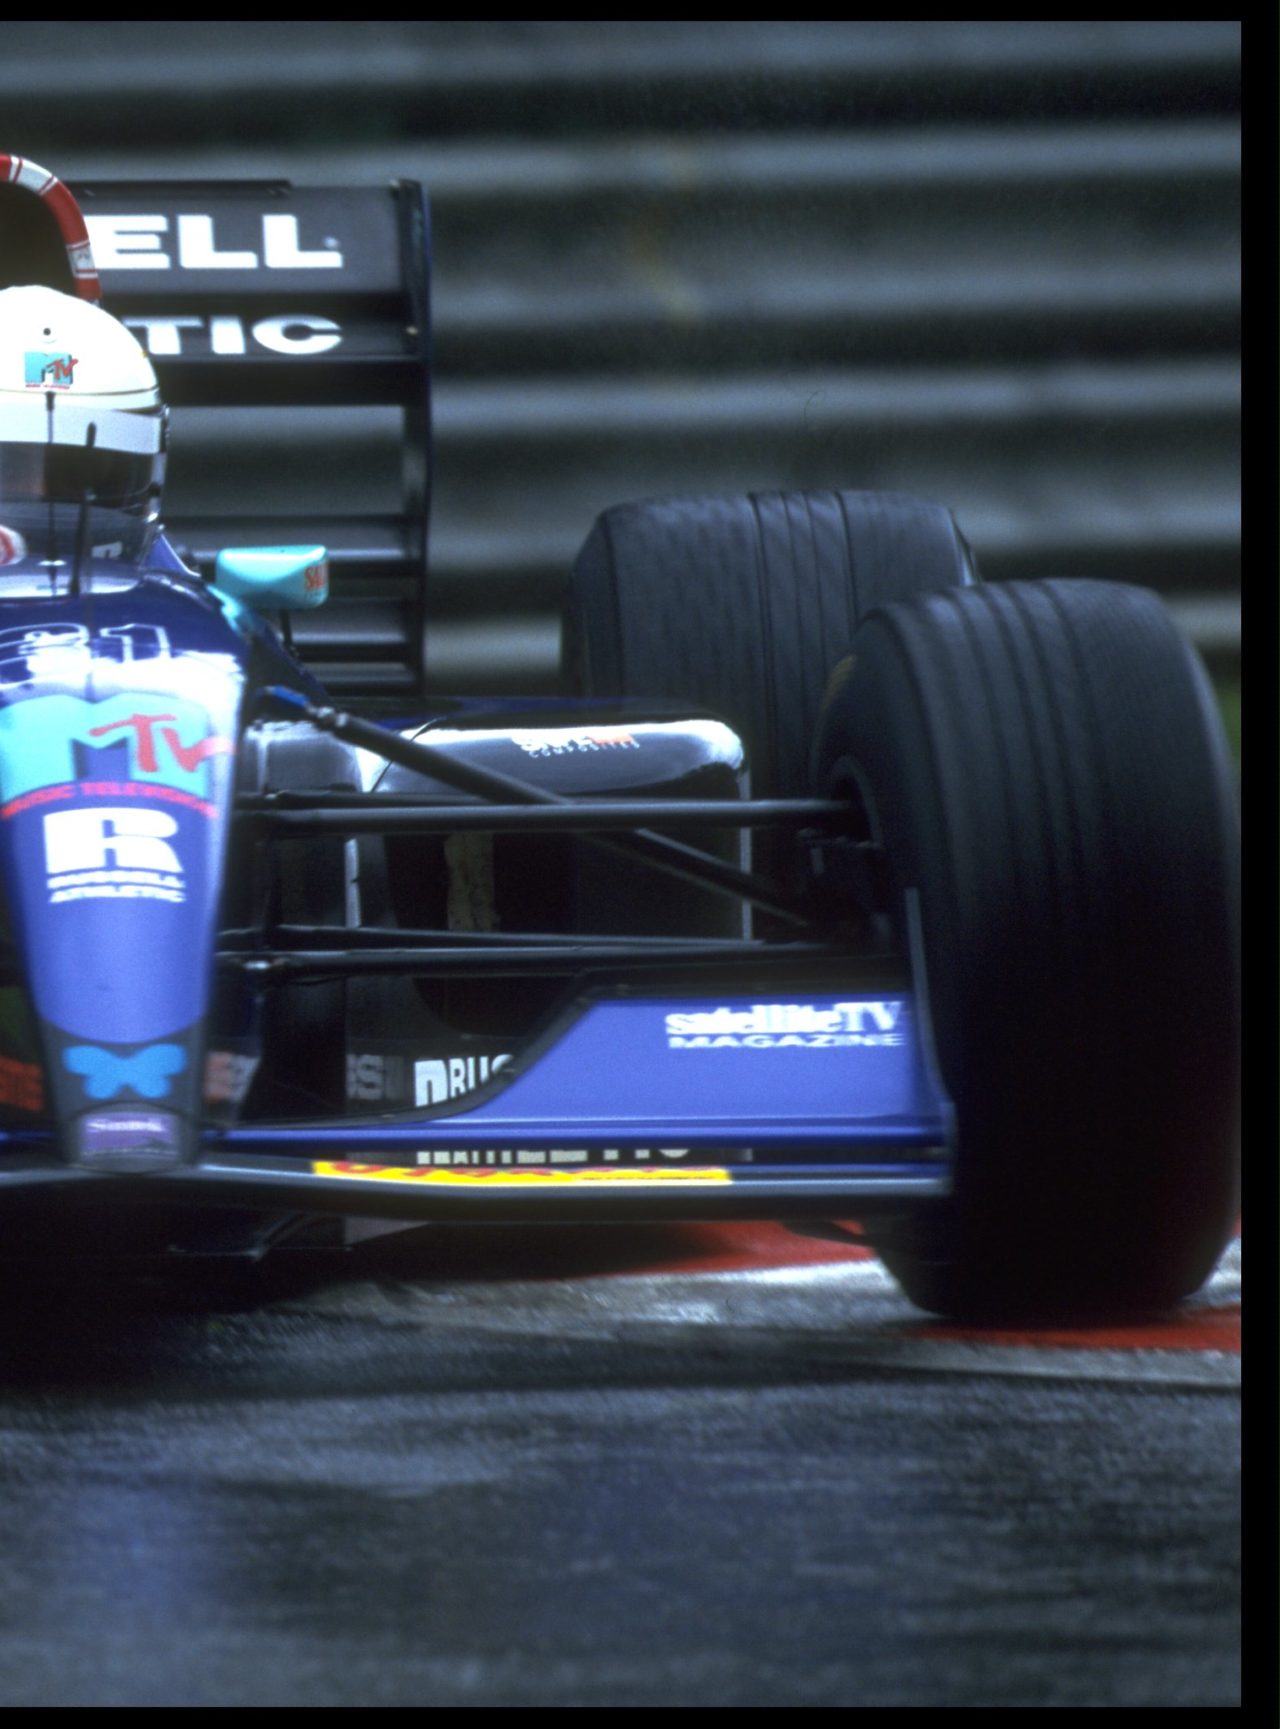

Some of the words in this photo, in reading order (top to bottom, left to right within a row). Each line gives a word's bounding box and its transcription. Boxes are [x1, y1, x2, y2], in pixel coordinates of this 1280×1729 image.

[24, 351, 79, 384] MTV
[42, 806, 185, 875] R
[668, 1033, 905, 1049] MAGAZINE
